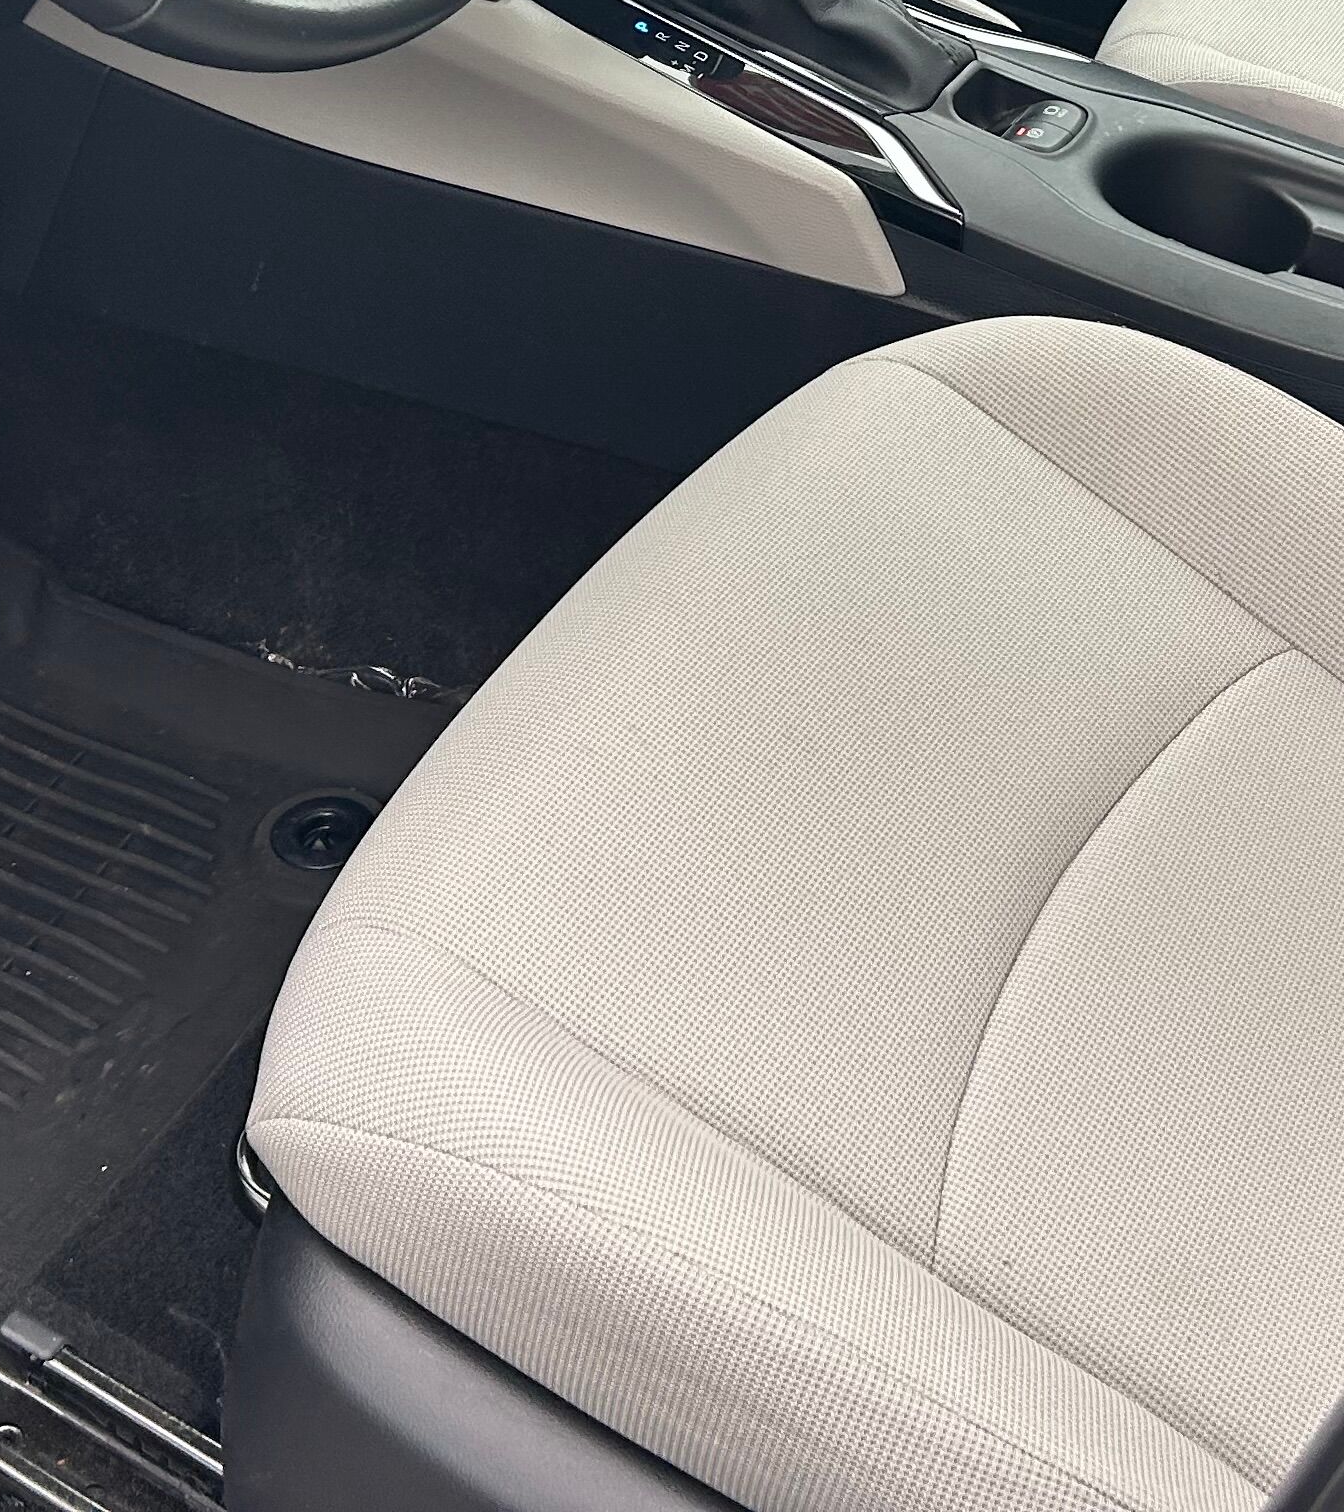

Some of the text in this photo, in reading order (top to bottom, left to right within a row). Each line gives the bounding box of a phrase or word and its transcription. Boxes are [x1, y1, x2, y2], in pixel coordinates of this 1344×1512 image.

[634, 21, 649, 33] P
[655, 31, 671, 41] R
[674, 40, 691, 52] N
[693, 50, 709, 62] D
